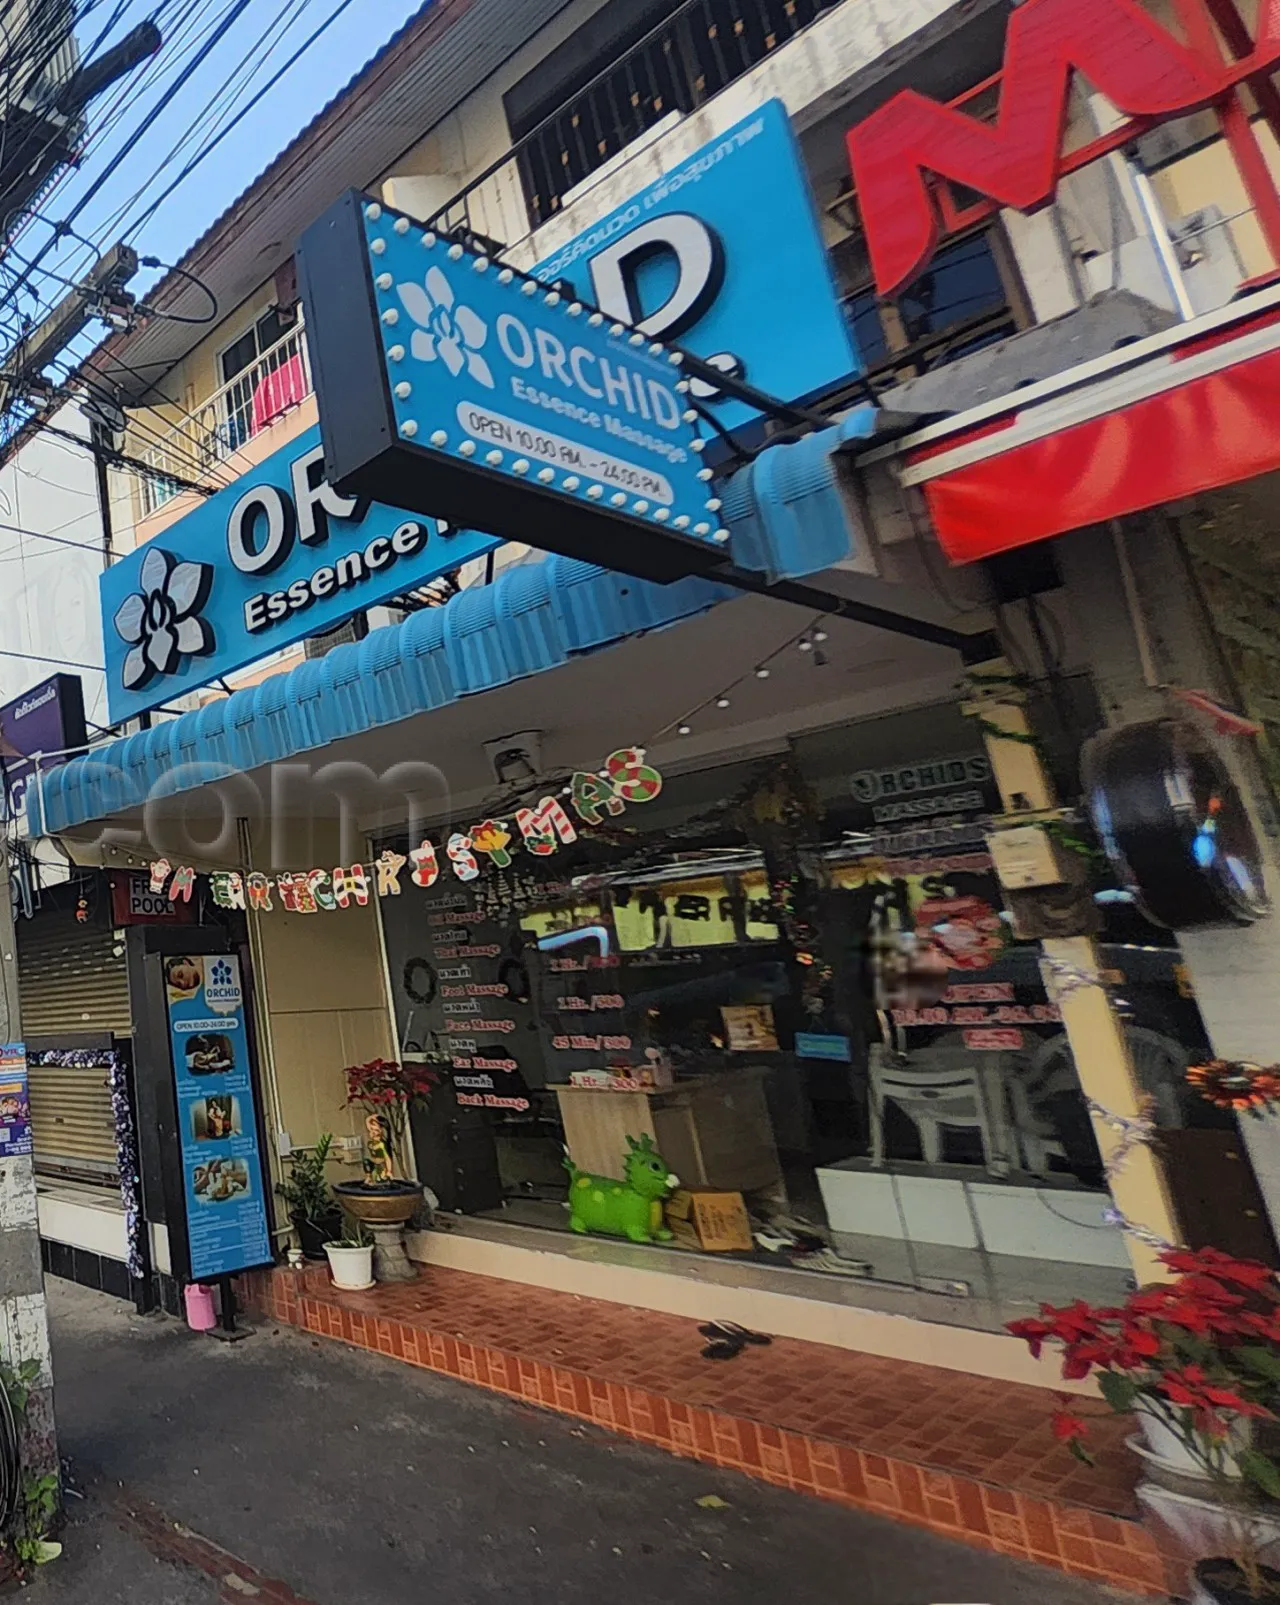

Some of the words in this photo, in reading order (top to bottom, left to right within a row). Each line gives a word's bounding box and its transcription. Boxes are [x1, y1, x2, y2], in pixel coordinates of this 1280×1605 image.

[496, 313, 681, 430] ORCHID
[468, 411, 513, 443] OPEN
[510, 375, 602, 428] Essence
[603, 413, 688, 464] Massage
[243, 521, 421, 634] Essence
[132, 897, 174, 914] POOL
[459, 944, 501, 958] Massage
[206, 987, 241, 998] ORCHID
[465, 982, 509, 997] Massage
[444, 1018, 471, 1032] Face
[471, 1018, 516, 1034] Massage
[452, 1056, 472, 1069] Ear
[472, 1056, 518, 1073] Massage
[455, 1092, 484, 1107] Back
[483, 1093, 530, 1112] Massage
